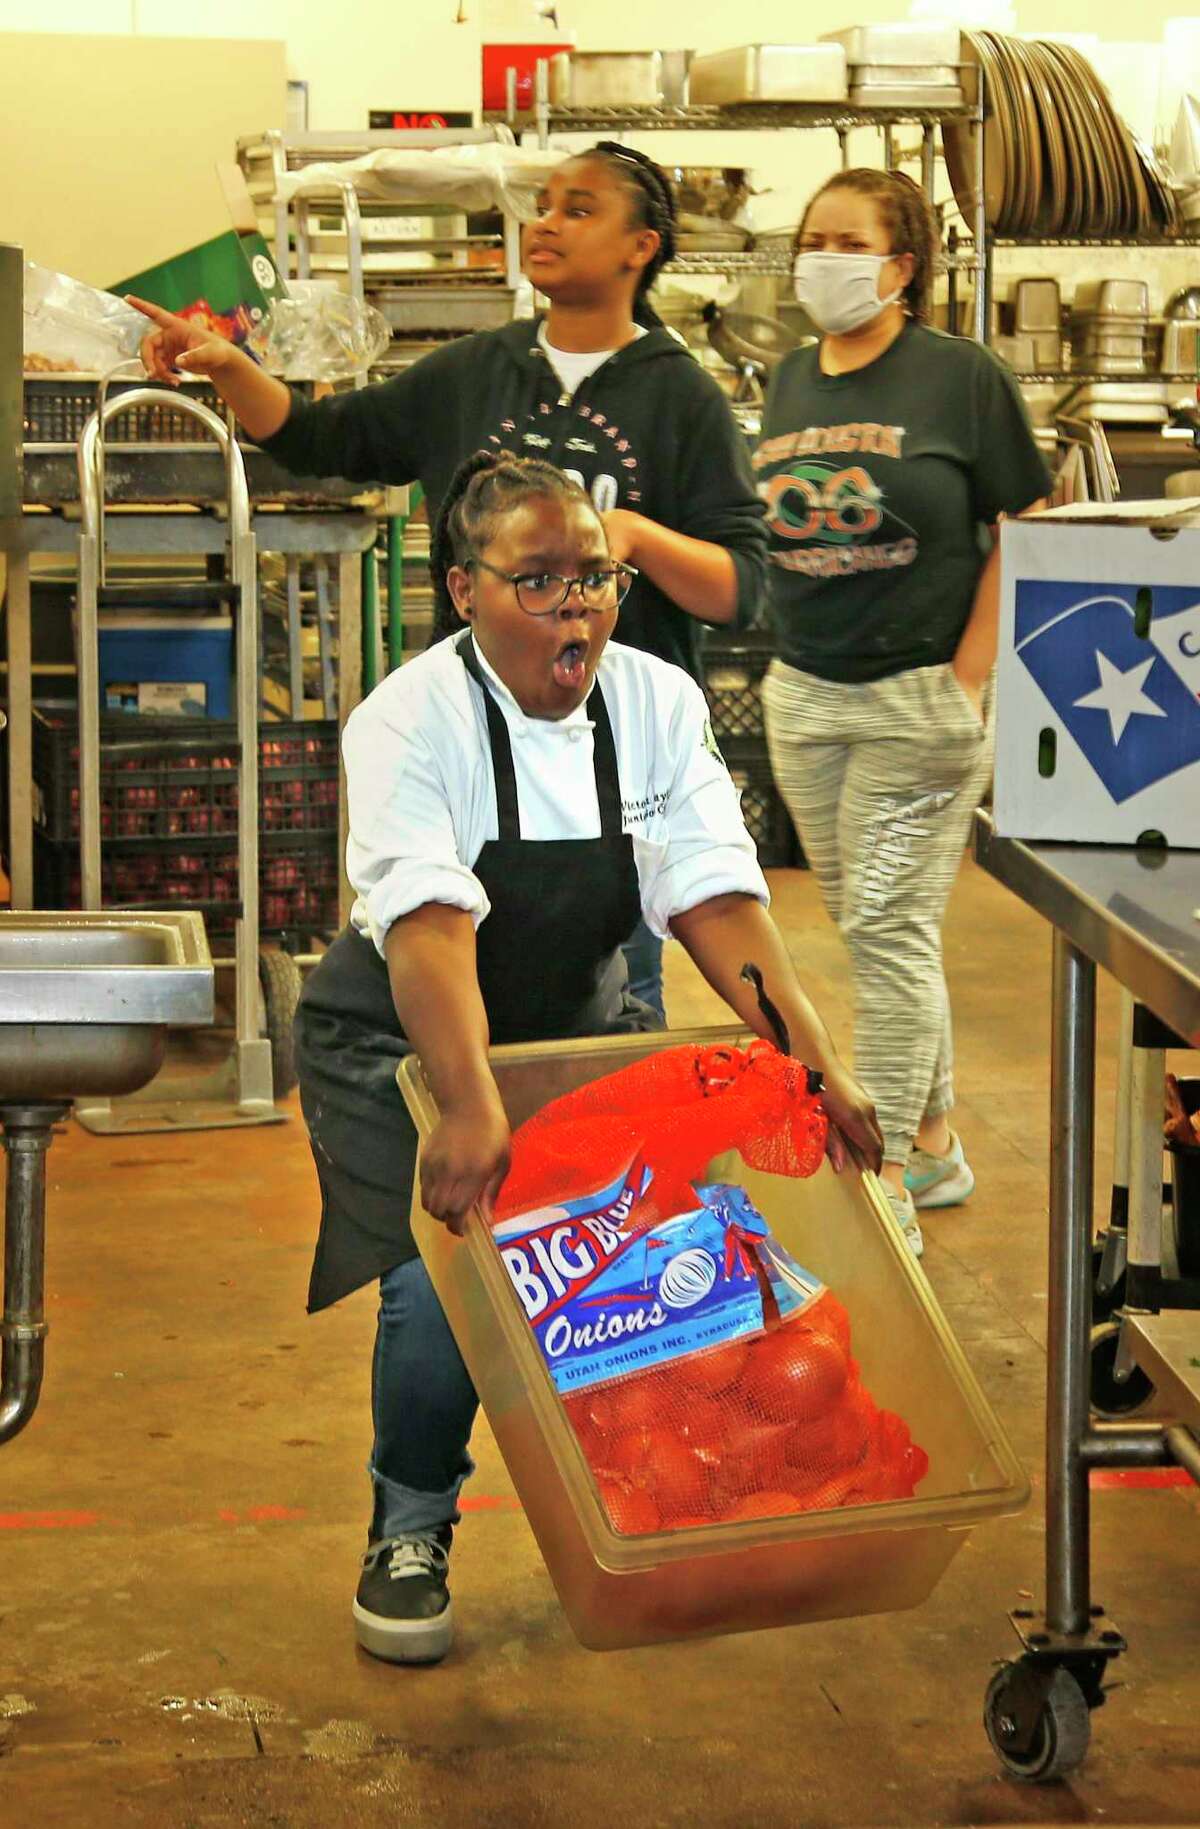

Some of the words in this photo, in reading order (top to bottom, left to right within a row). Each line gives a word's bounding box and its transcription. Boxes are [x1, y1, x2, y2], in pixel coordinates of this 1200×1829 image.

[500, 1226, 595, 1320] BIG
[582, 1189, 634, 1256] BLUE
[545, 1301, 668, 1358] Onions
[565, 1362, 600, 1381] UTAH
[605, 1344, 659, 1369] ONIONS
[662, 1335, 691, 1351] INC.
